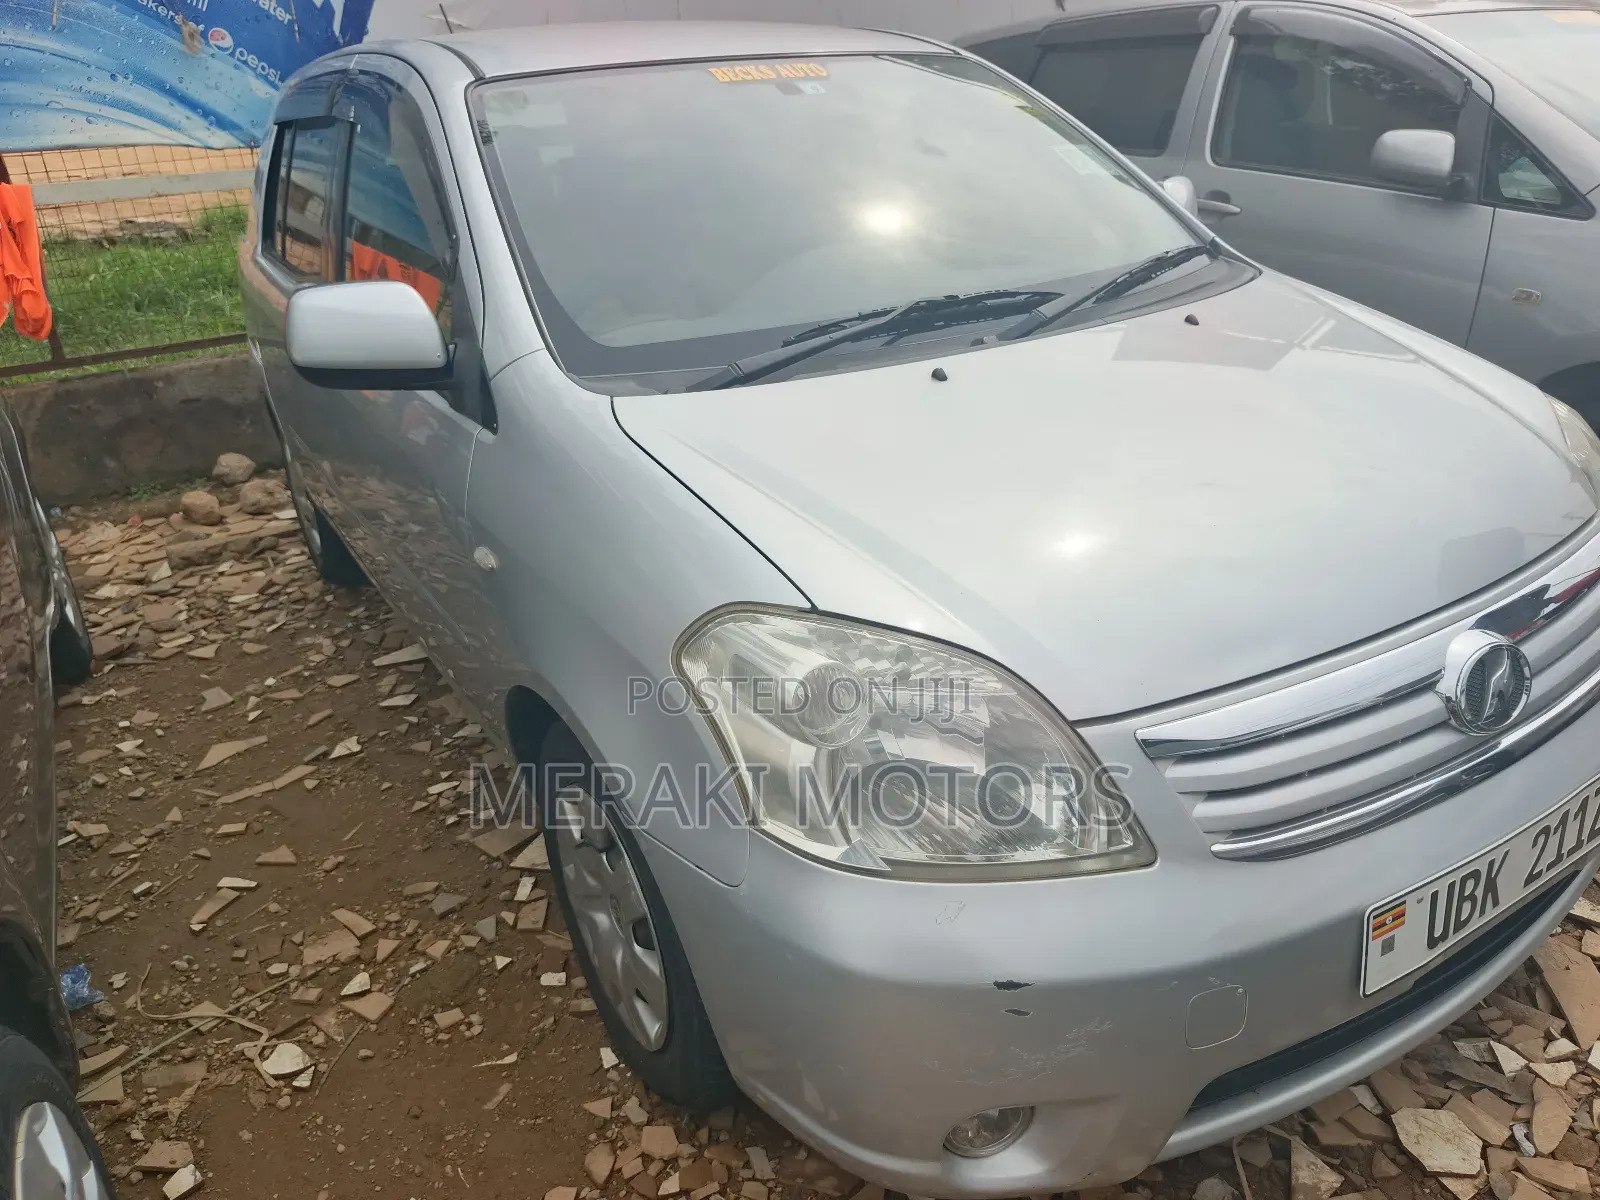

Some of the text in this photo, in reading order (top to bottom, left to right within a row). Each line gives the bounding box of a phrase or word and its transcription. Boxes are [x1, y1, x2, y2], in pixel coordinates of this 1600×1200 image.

[252, 0, 292, 24] ater
[234, 47, 281, 84] pepsi
[775, 63, 828, 78] AUTO
[1427, 849, 1510, 950] UBK
